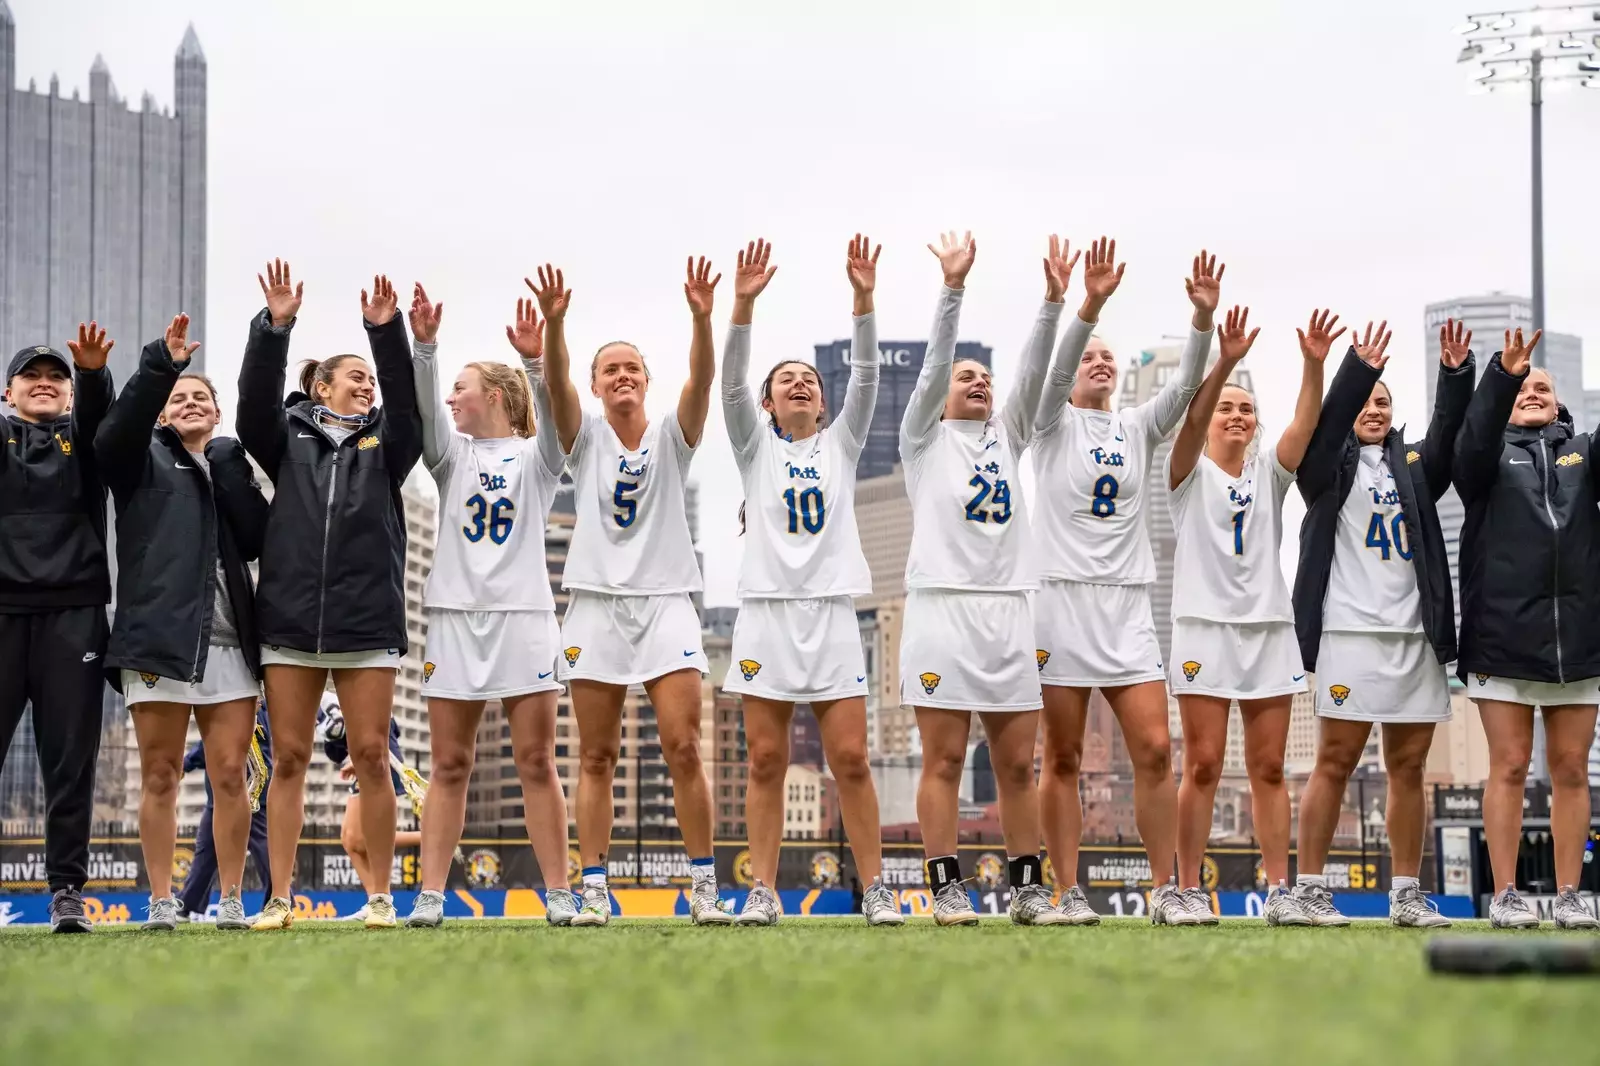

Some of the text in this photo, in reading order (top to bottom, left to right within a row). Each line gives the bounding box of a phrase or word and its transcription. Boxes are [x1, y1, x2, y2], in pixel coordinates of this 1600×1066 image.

[842, 349, 911, 366] UMC
[1089, 446, 1125, 467] Pitt
[479, 472, 507, 492] Pitt
[613, 479, 639, 529] 5
[965, 473, 1012, 525] 29
[1091, 474, 1119, 519] 8
[462, 493, 516, 546] 36
[782, 487, 826, 536] 10
[1231, 510, 1246, 556] 1
[1365, 511, 1413, 562] 40
[1, 861, 138, 881] RIVEUNDS
[323, 868, 402, 885] RIVES
[608, 861, 692, 876] RIVRHOUN
[1088, 865, 1151, 880] RIVERHOU
[1350, 863, 1377, 888] SC
[1108, 892, 1146, 916] 12
